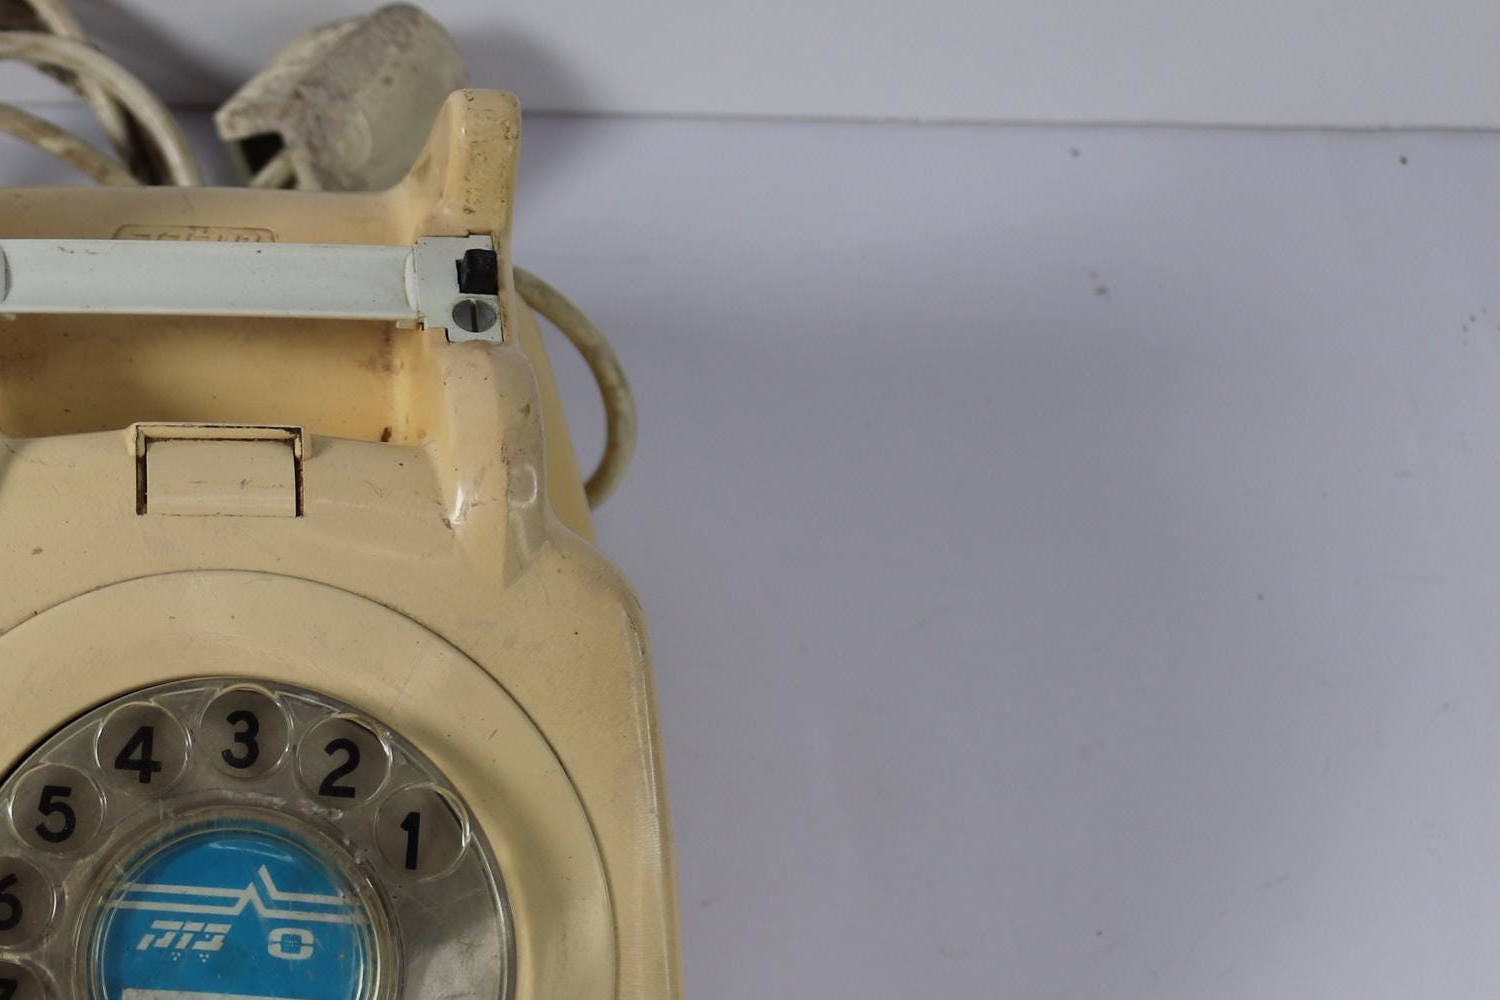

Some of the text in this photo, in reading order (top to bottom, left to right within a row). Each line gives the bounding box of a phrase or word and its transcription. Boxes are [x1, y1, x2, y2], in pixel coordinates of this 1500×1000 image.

[114, 726, 162, 784] 4
[221, 710, 260, 769] 3
[318, 738, 361, 798] 2
[35, 785, 77, 843] 5
[400, 812, 421, 870] 1
